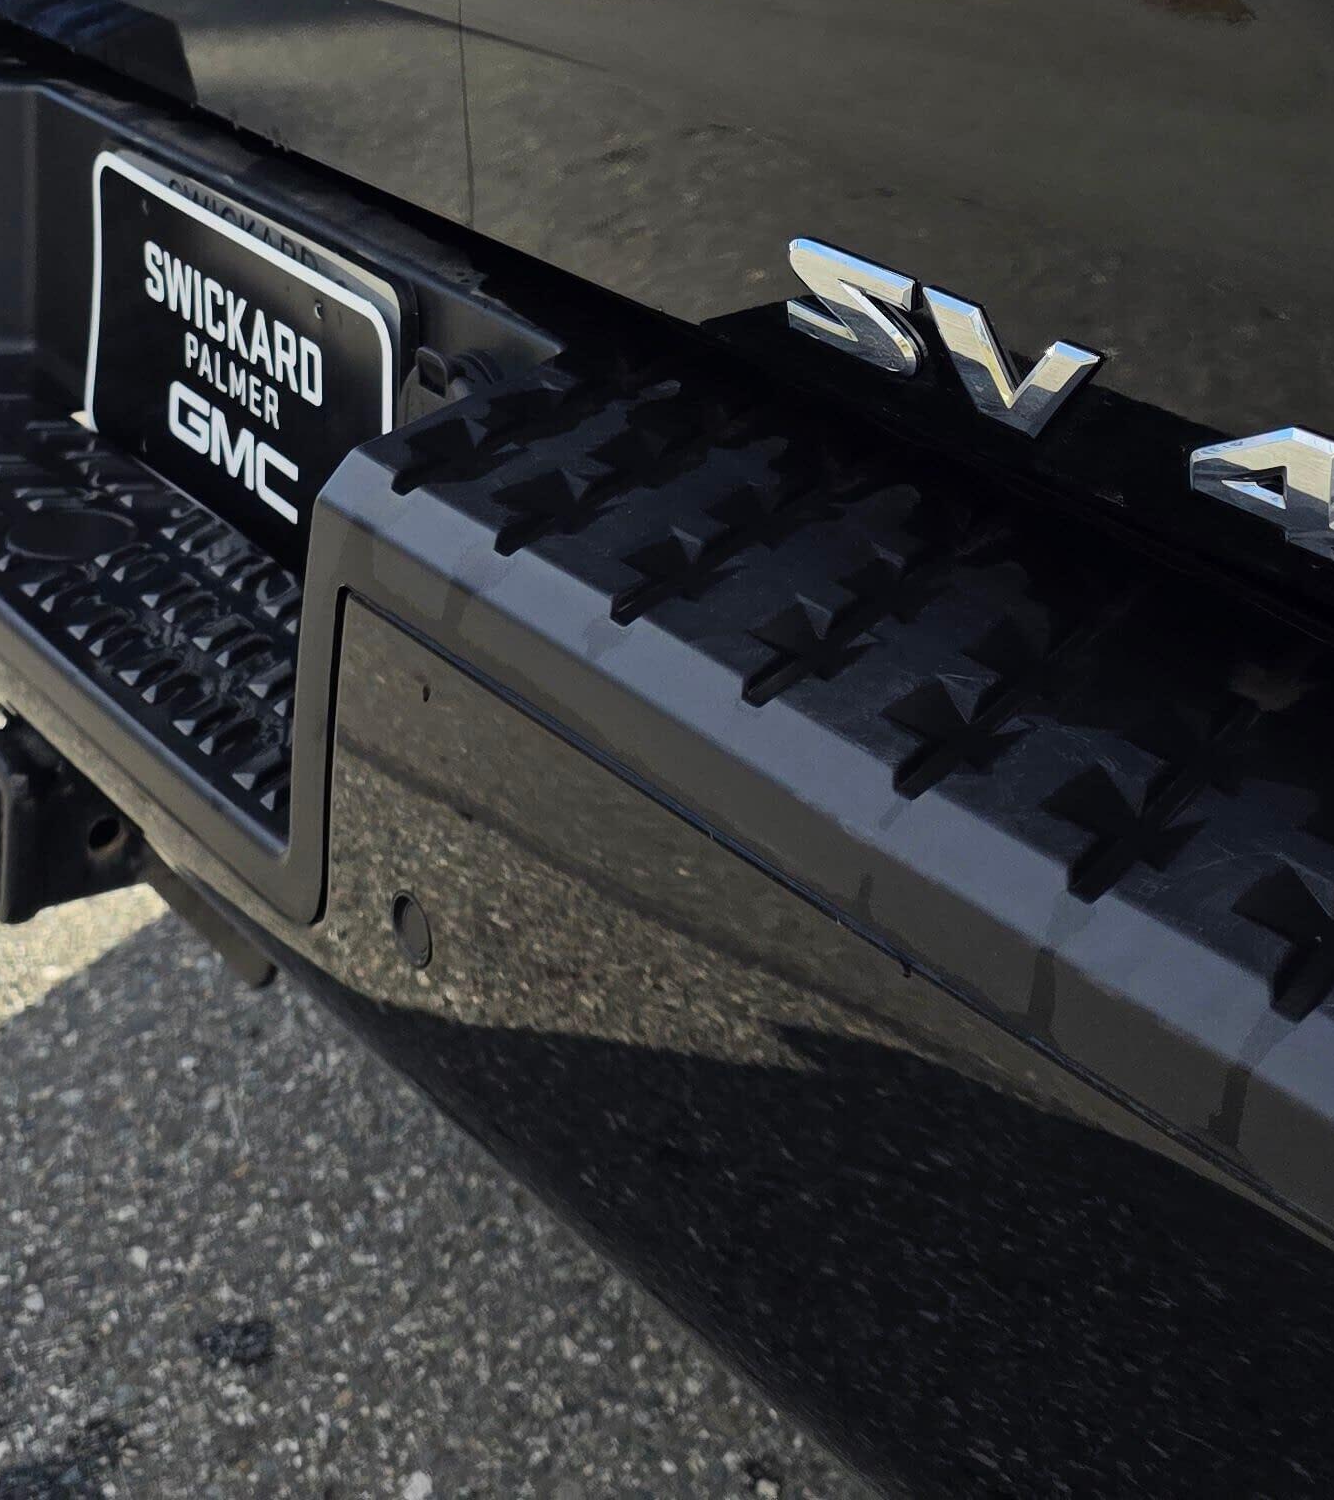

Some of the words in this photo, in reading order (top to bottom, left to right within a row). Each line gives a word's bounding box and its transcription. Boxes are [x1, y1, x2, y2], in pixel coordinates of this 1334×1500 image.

[143, 240, 323, 407] SWICKARD
[184, 332, 280, 430] PALMER
[787, 235, 1102, 440] SV
[169, 380, 299, 525] GMC
